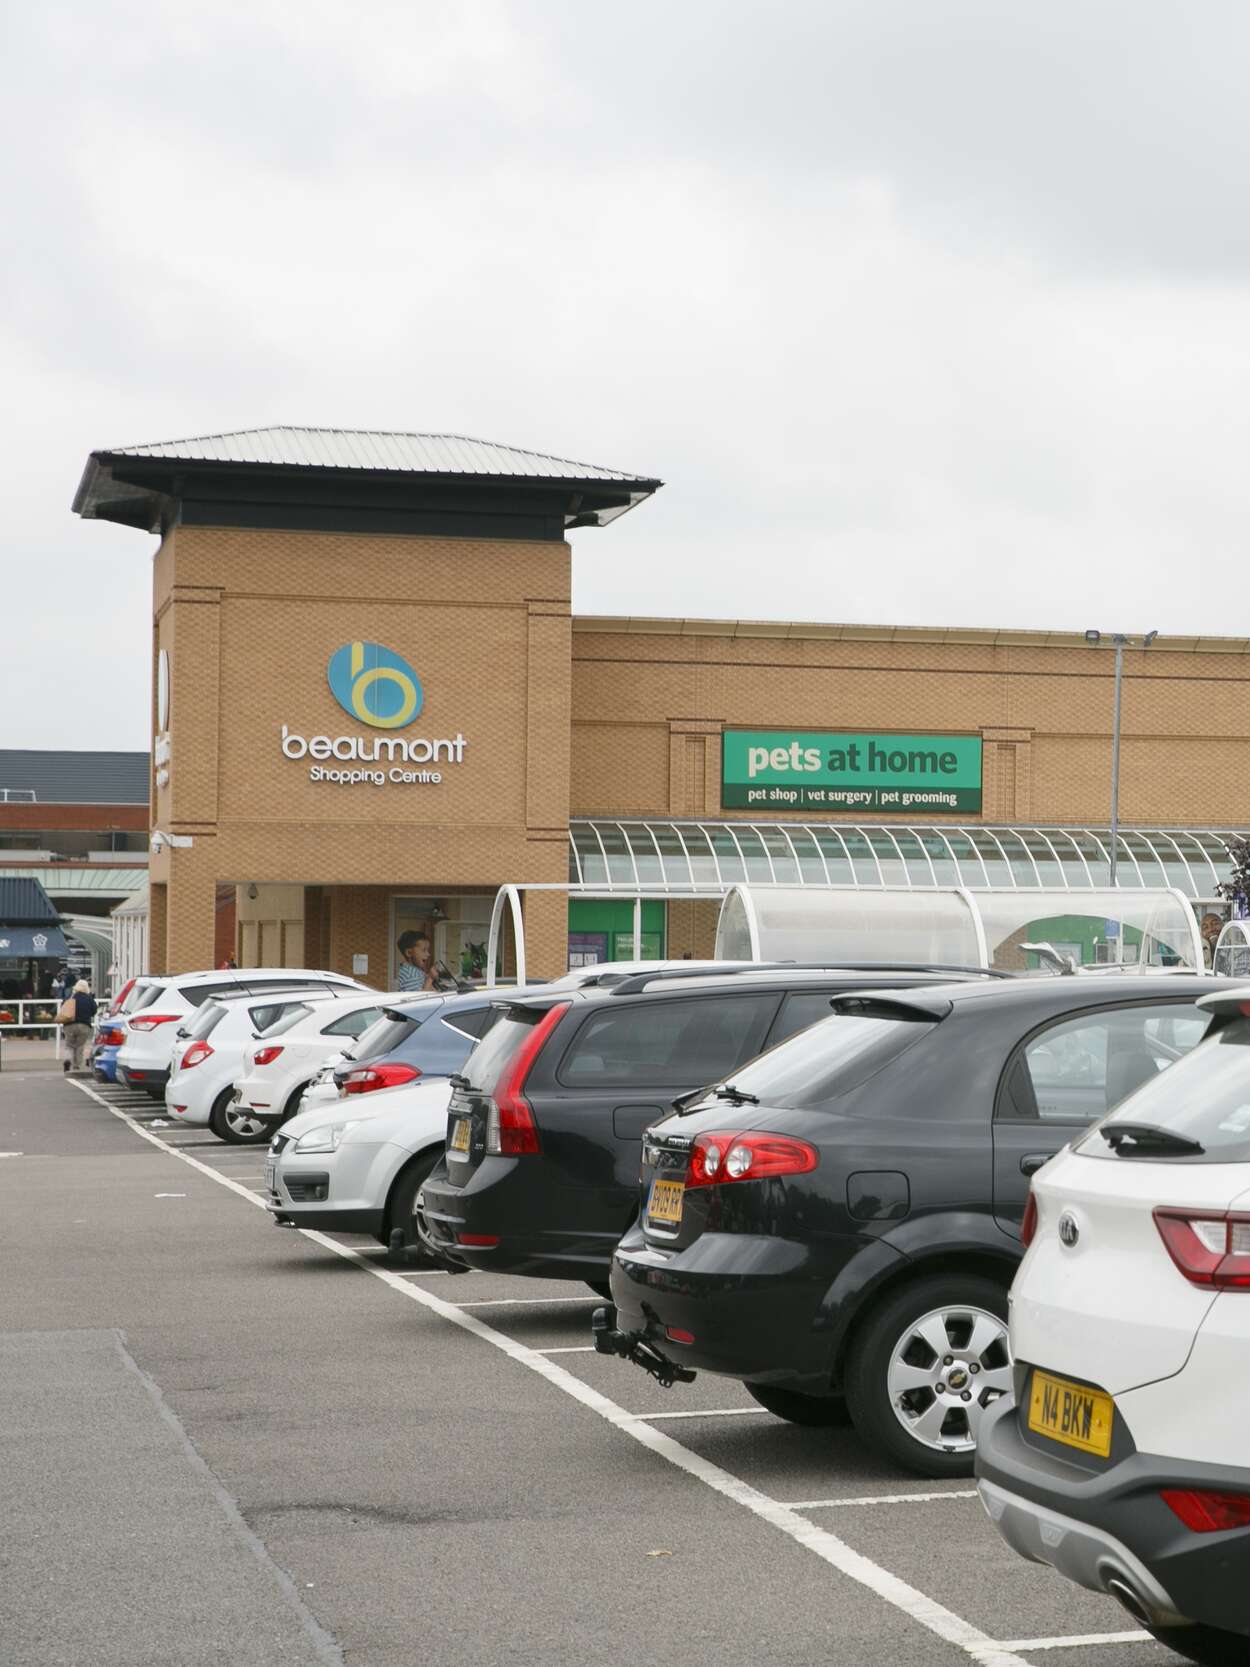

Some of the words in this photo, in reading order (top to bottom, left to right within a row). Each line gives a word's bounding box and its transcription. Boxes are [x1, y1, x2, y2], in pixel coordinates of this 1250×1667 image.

[282, 725, 467, 763] beaumont
[748, 742, 821, 778] pets
[828, 743, 860, 772] at
[868, 741, 957, 774] home
[310, 766, 385, 785] Shopping
[389, 767, 441, 783] Centre
[748, 788, 766, 802] pet
[770, 788, 797, 804] shop
[808, 791, 826, 801] vet
[828, 791, 872, 805] surgery
[881, 791, 899, 806] pet
[902, 791, 957, 807] grooming
[1041, 1382, 1060, 1429] N4
